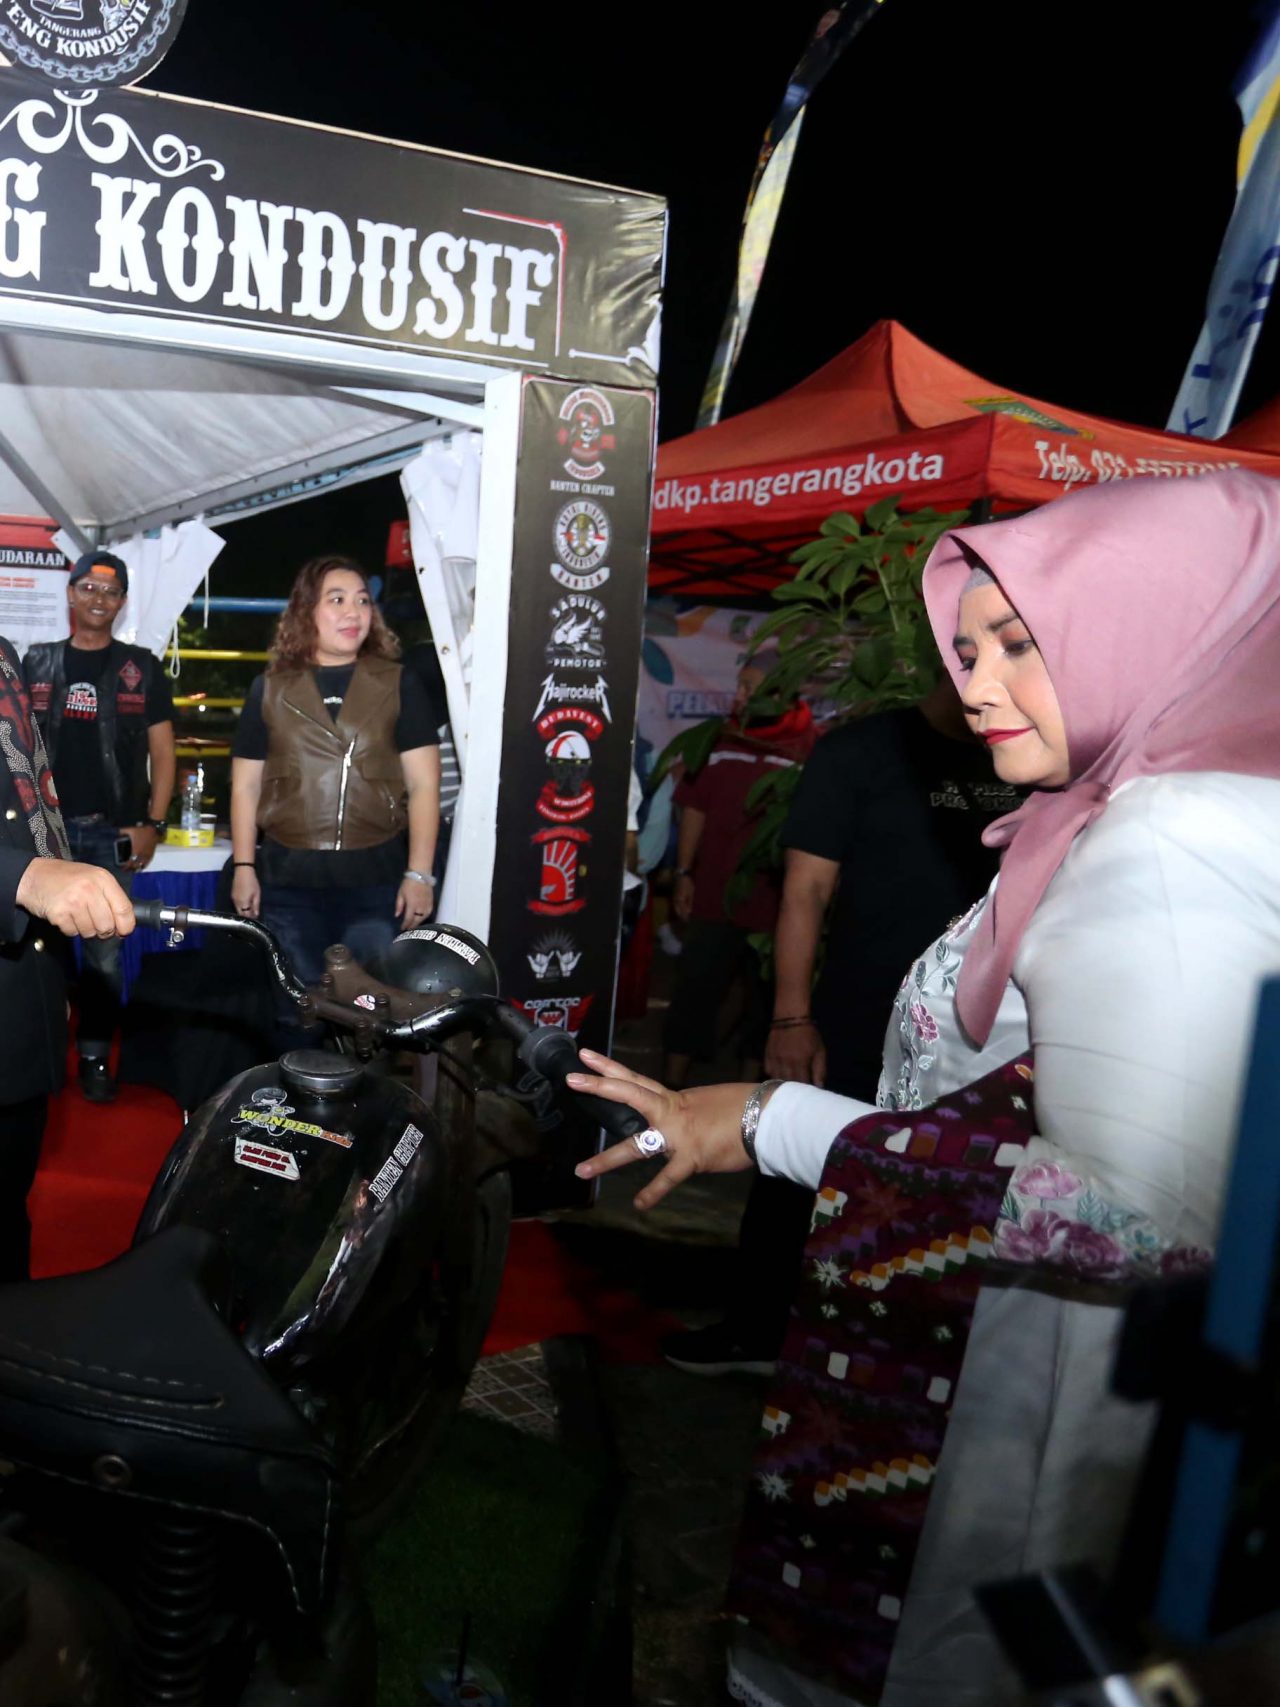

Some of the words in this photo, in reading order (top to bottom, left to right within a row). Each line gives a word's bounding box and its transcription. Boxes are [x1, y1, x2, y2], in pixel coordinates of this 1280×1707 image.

[39, 14, 102, 38] TANGERANG
[56, 0, 152, 58] KONDUSIF
[89, 173, 556, 352] KONDUSIF
[654, 452, 945, 511] dkp.tangerangkota
[239, 1108, 323, 1138] WONDER
